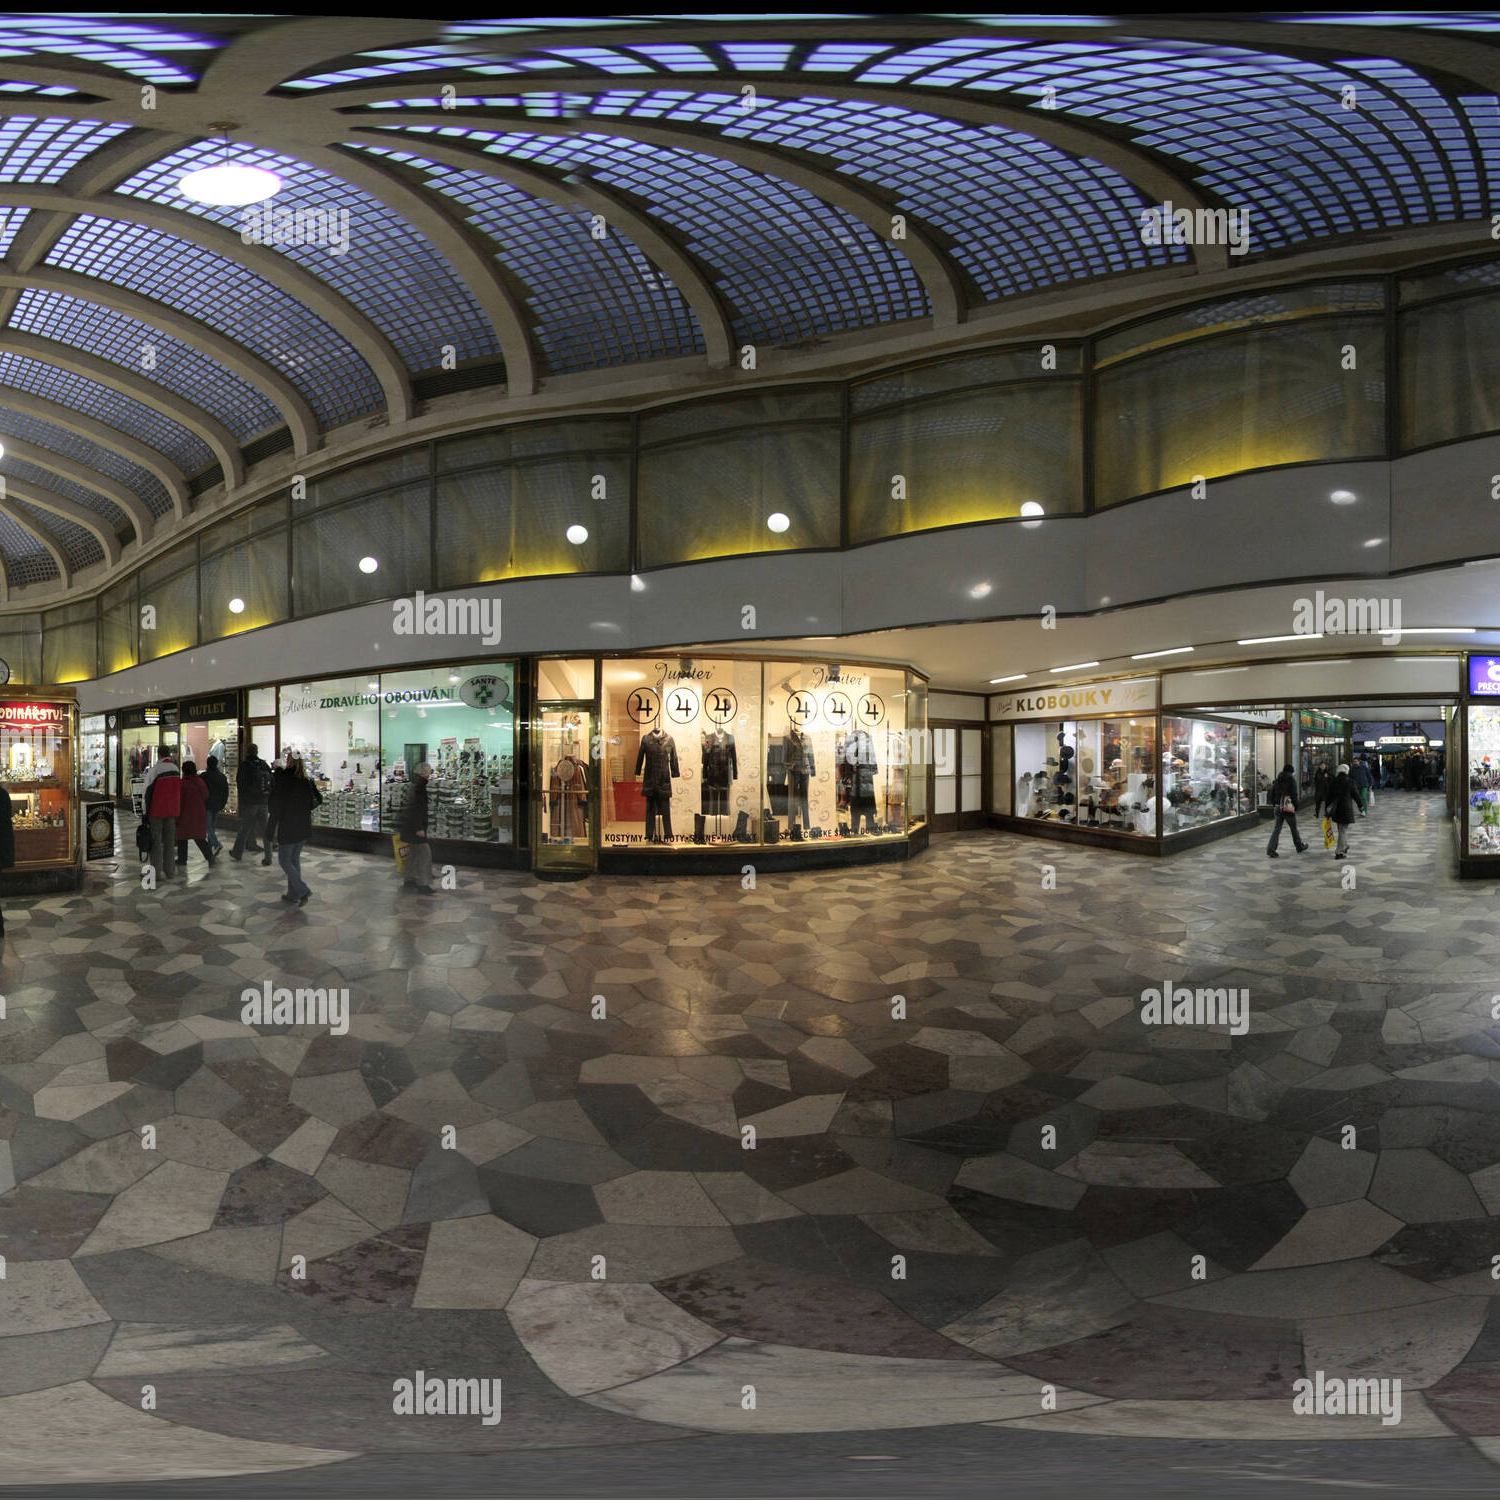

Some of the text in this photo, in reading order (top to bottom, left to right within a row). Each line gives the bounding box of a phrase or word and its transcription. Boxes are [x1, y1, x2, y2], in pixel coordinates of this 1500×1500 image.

[655, 662, 713, 686] Jupiter
[813, 666, 863, 689] Jupiter
[189, 702, 227, 716] OUTLET
[320, 692, 379, 709] ZDRAVÉHO
[1016, 689, 1113, 712] KLOBOUKY
